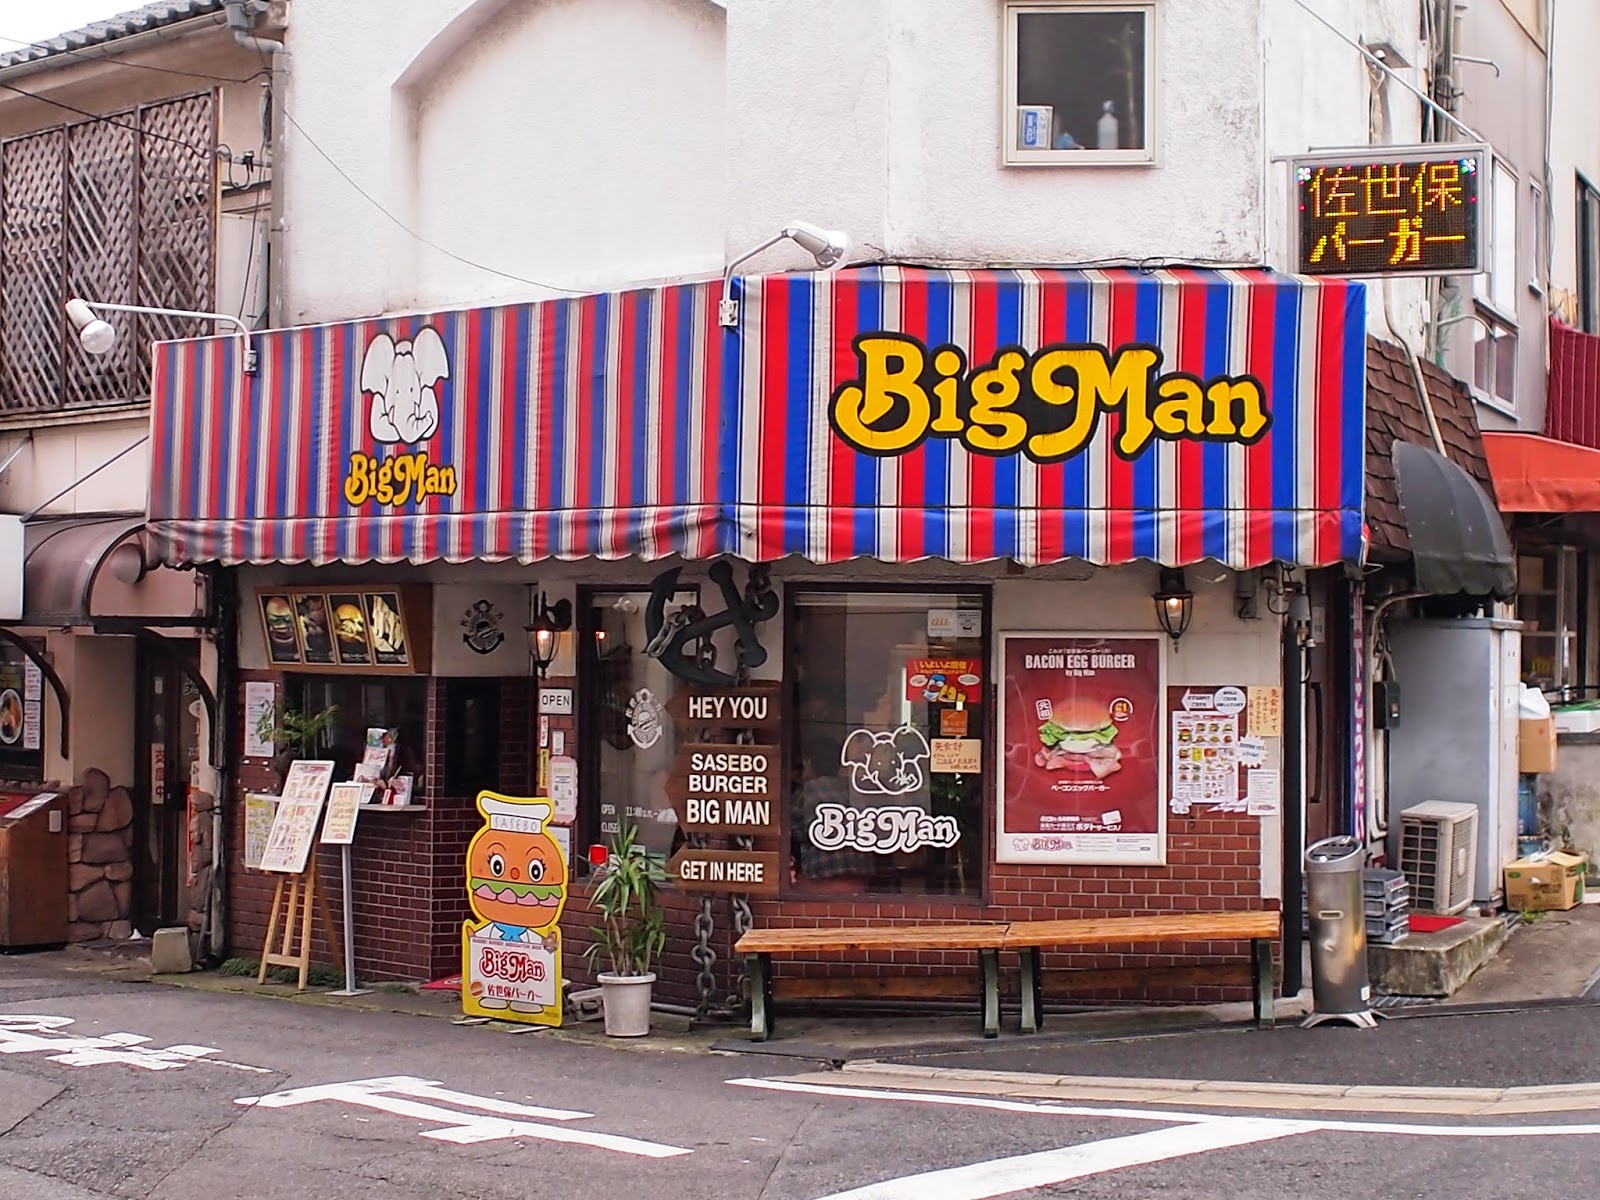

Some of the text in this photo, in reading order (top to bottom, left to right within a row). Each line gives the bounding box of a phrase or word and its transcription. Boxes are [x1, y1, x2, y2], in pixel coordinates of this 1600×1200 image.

[1309, 163, 1462, 217] 佐世保
[1309, 216, 1466, 265] バーガー
[1025, 654, 1136, 669] BACON EGG BURGER
[541, 695, 570, 707] OPEN
[689, 697, 725, 719] HEY
[729, 697, 768, 719] YOU
[691, 753, 767, 773] SASEBO
[689, 775, 767, 794] BURGER
[601, 804, 616, 815] OPEN
[687, 799, 770, 825] BIG MAN
[494, 816, 537, 832] SASEBO
[681, 861, 764, 882] GET IN HERE
[488, 984, 541, 1001] 佐世保バーガー
